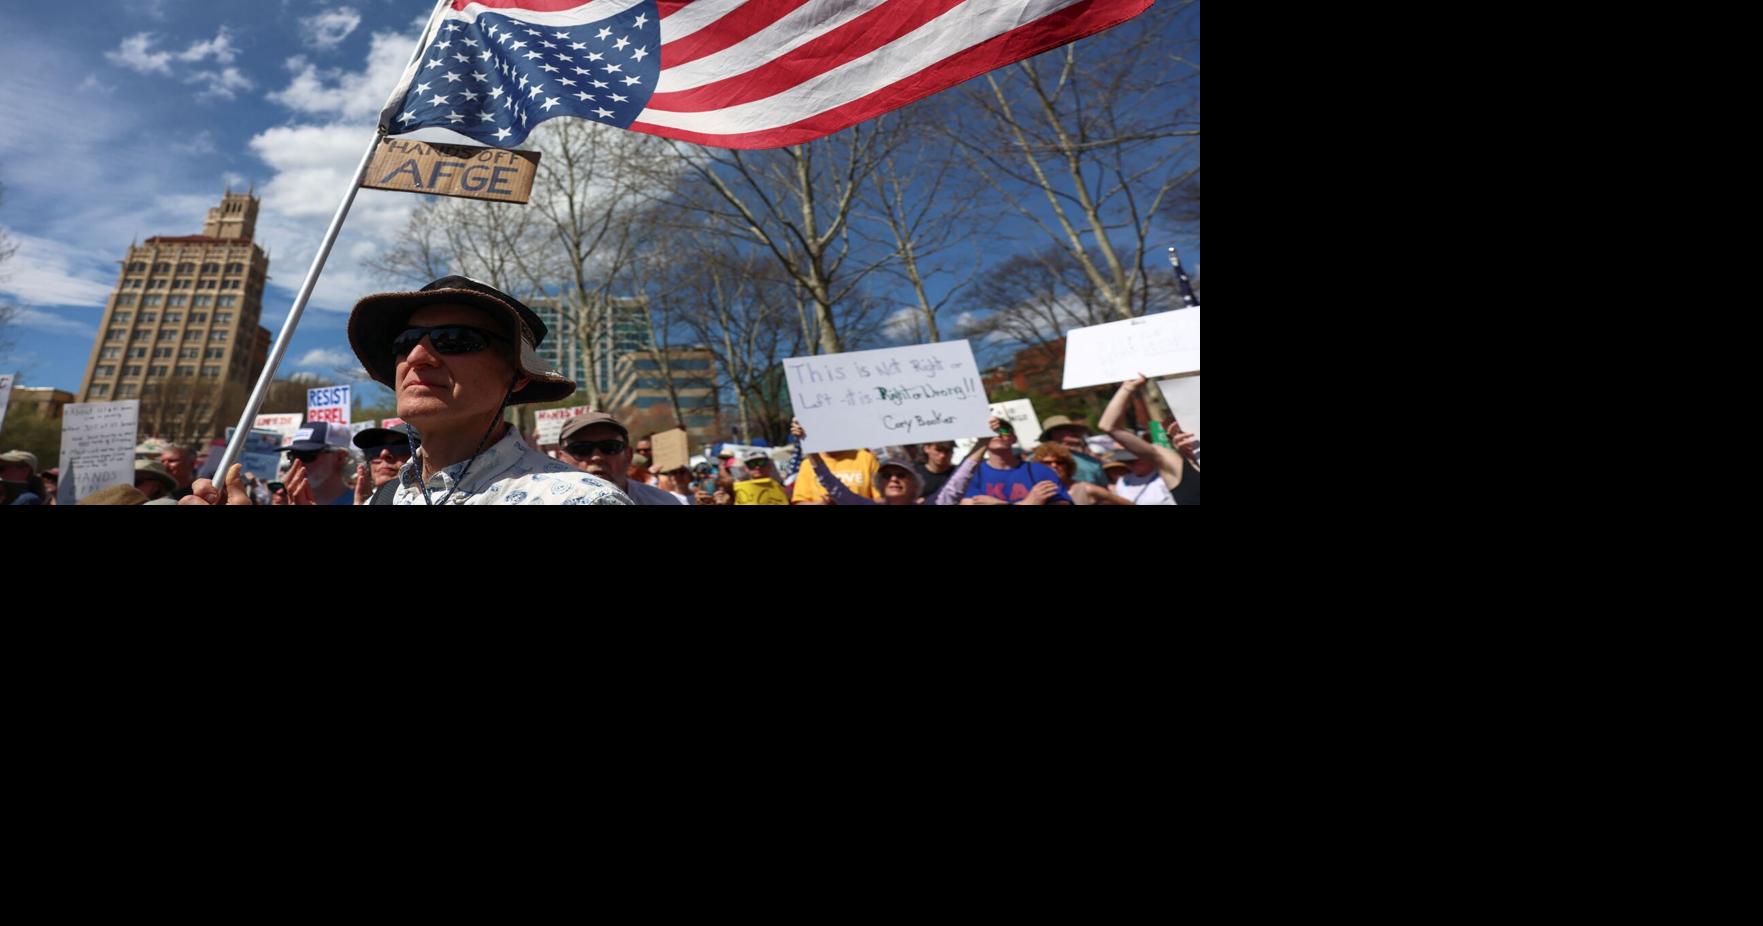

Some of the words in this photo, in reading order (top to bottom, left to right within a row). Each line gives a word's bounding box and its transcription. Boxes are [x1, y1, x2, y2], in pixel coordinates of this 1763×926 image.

[478, 150, 521, 165] OFF
[380, 158, 519, 195] AFGE
[788, 362, 847, 384] This
[853, 362, 871, 378] is
[875, 358, 901, 377] Not
[910, 356, 944, 378] Right
[309, 387, 349, 407] RESIST
[798, 392, 833, 411] Left
[859, 391, 874, 405] is
[873, 385, 911, 406] Right
[882, 415, 913, 434] Cory
[914, 409, 957, 427] Booker
